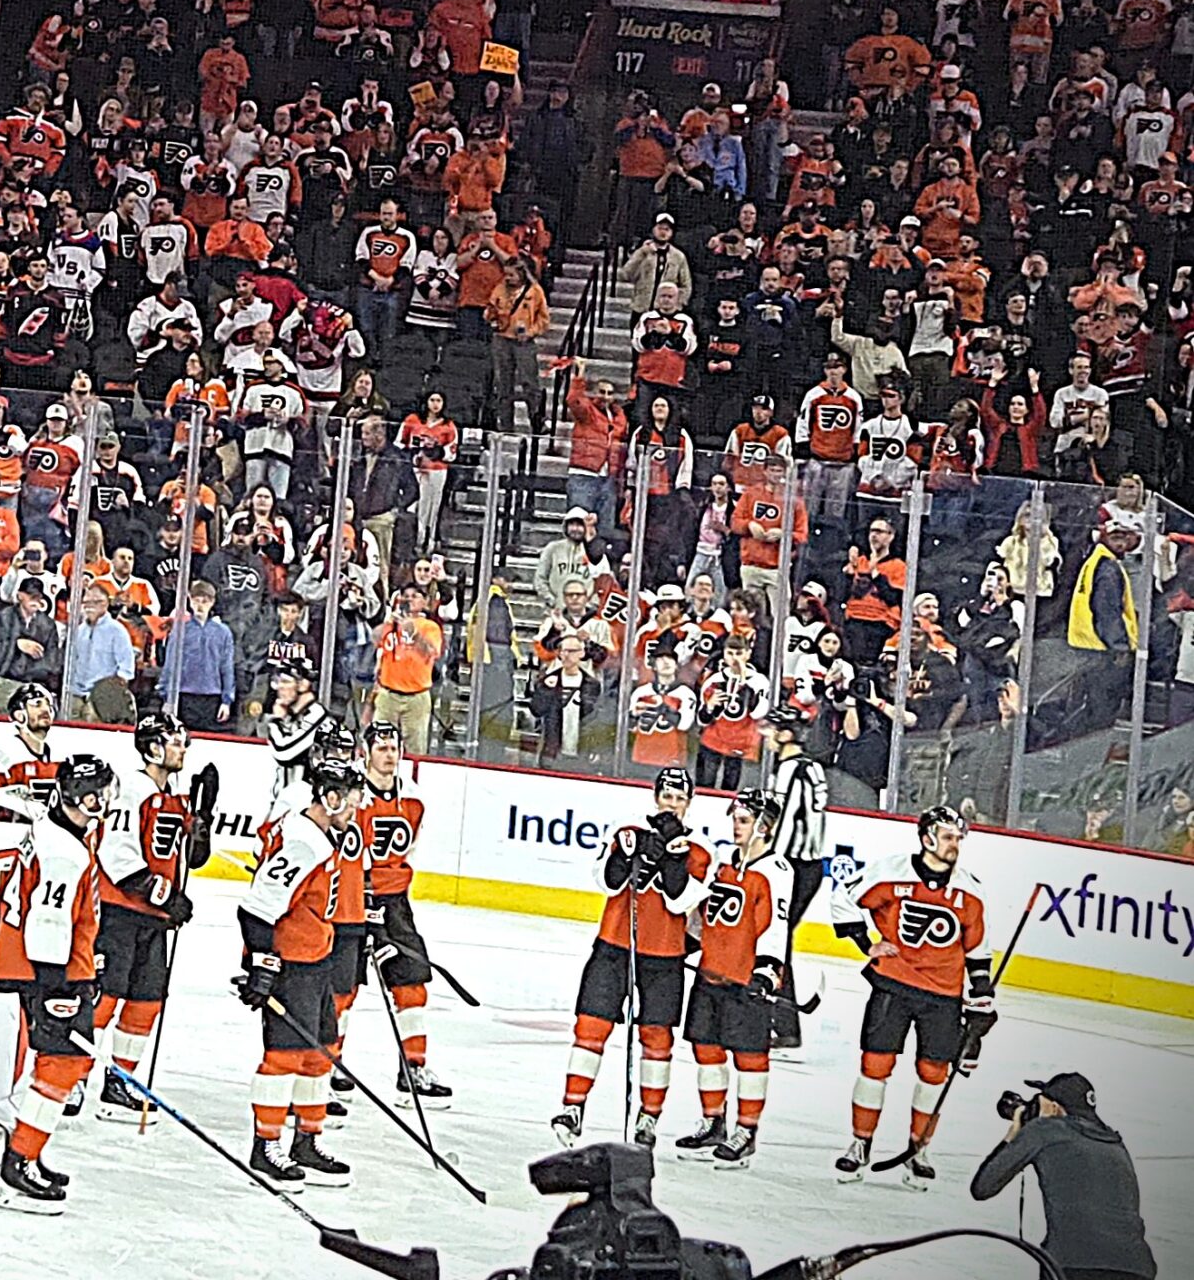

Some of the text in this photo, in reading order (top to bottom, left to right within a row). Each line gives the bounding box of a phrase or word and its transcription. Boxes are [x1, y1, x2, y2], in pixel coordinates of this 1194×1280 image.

[617, 18, 666, 39] Hard
[666, 21, 713, 47] Rock
[616, 51, 645, 73] 117
[267, 857, 301, 888] 24
[41, 880, 67, 909] 14
